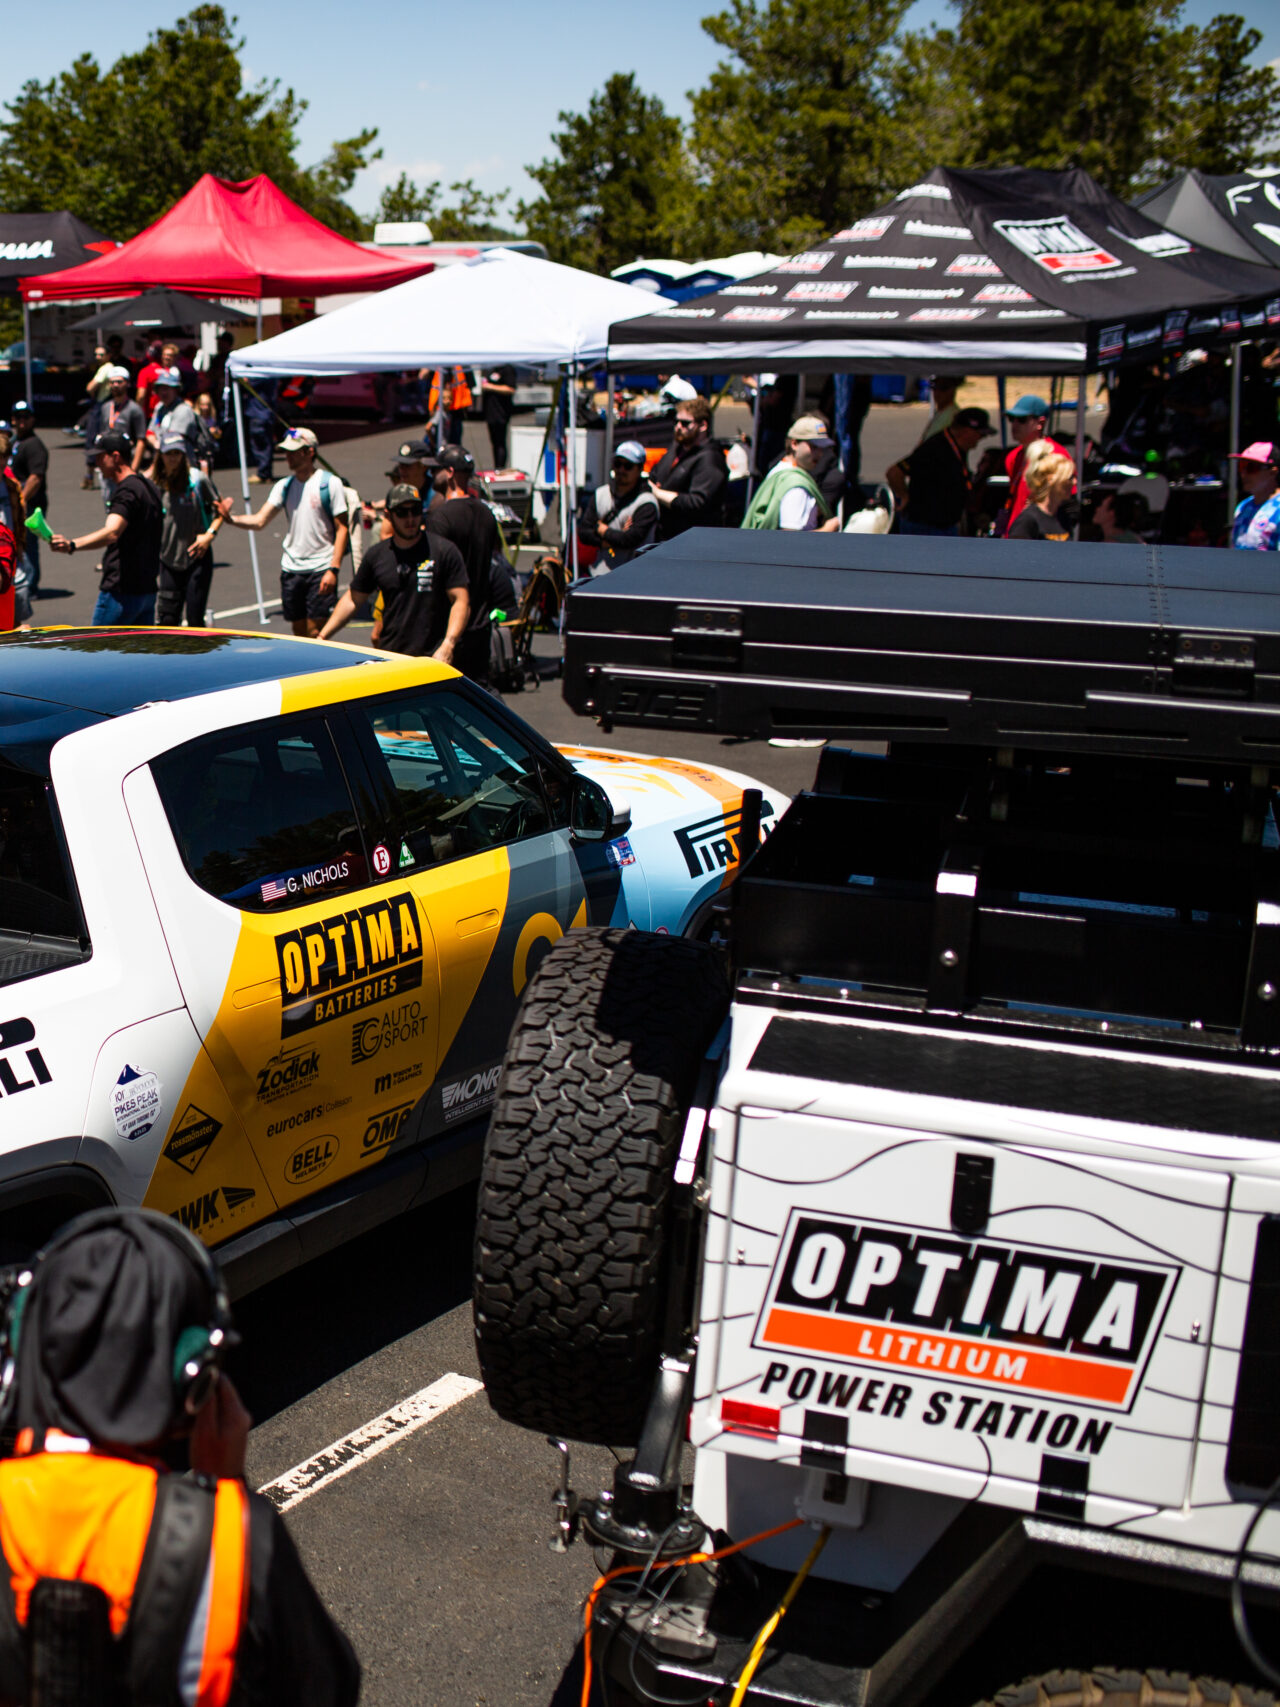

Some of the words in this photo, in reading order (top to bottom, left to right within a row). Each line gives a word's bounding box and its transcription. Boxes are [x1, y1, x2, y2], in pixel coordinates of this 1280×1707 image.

[287, 876, 301, 894] G.
[302, 861, 350, 890] NICHOLS
[375, 849, 389, 872] E
[282, 902, 420, 996] OPTIMA
[314, 974, 398, 1023] BATTERIES
[381, 1001, 421, 1031] AUTO
[384, 1016, 429, 1049] SPORT
[257, 1051, 320, 1096] Zodiak
[114, 1098, 137, 1117] PIKES
[136, 1087, 158, 1106] PEAK
[266, 1104, 323, 1138] eurocars
[363, 1107, 412, 1148] OMP
[292, 1141, 333, 1175] BELL
[295, 1161, 327, 1180] HELMETS
[790, 1231, 1139, 1351] OPTIMA
[856, 1329, 1029, 1382] LITHIUM
[759, 1361, 913, 1419] POWER
[921, 1389, 1113, 1456] STATION
